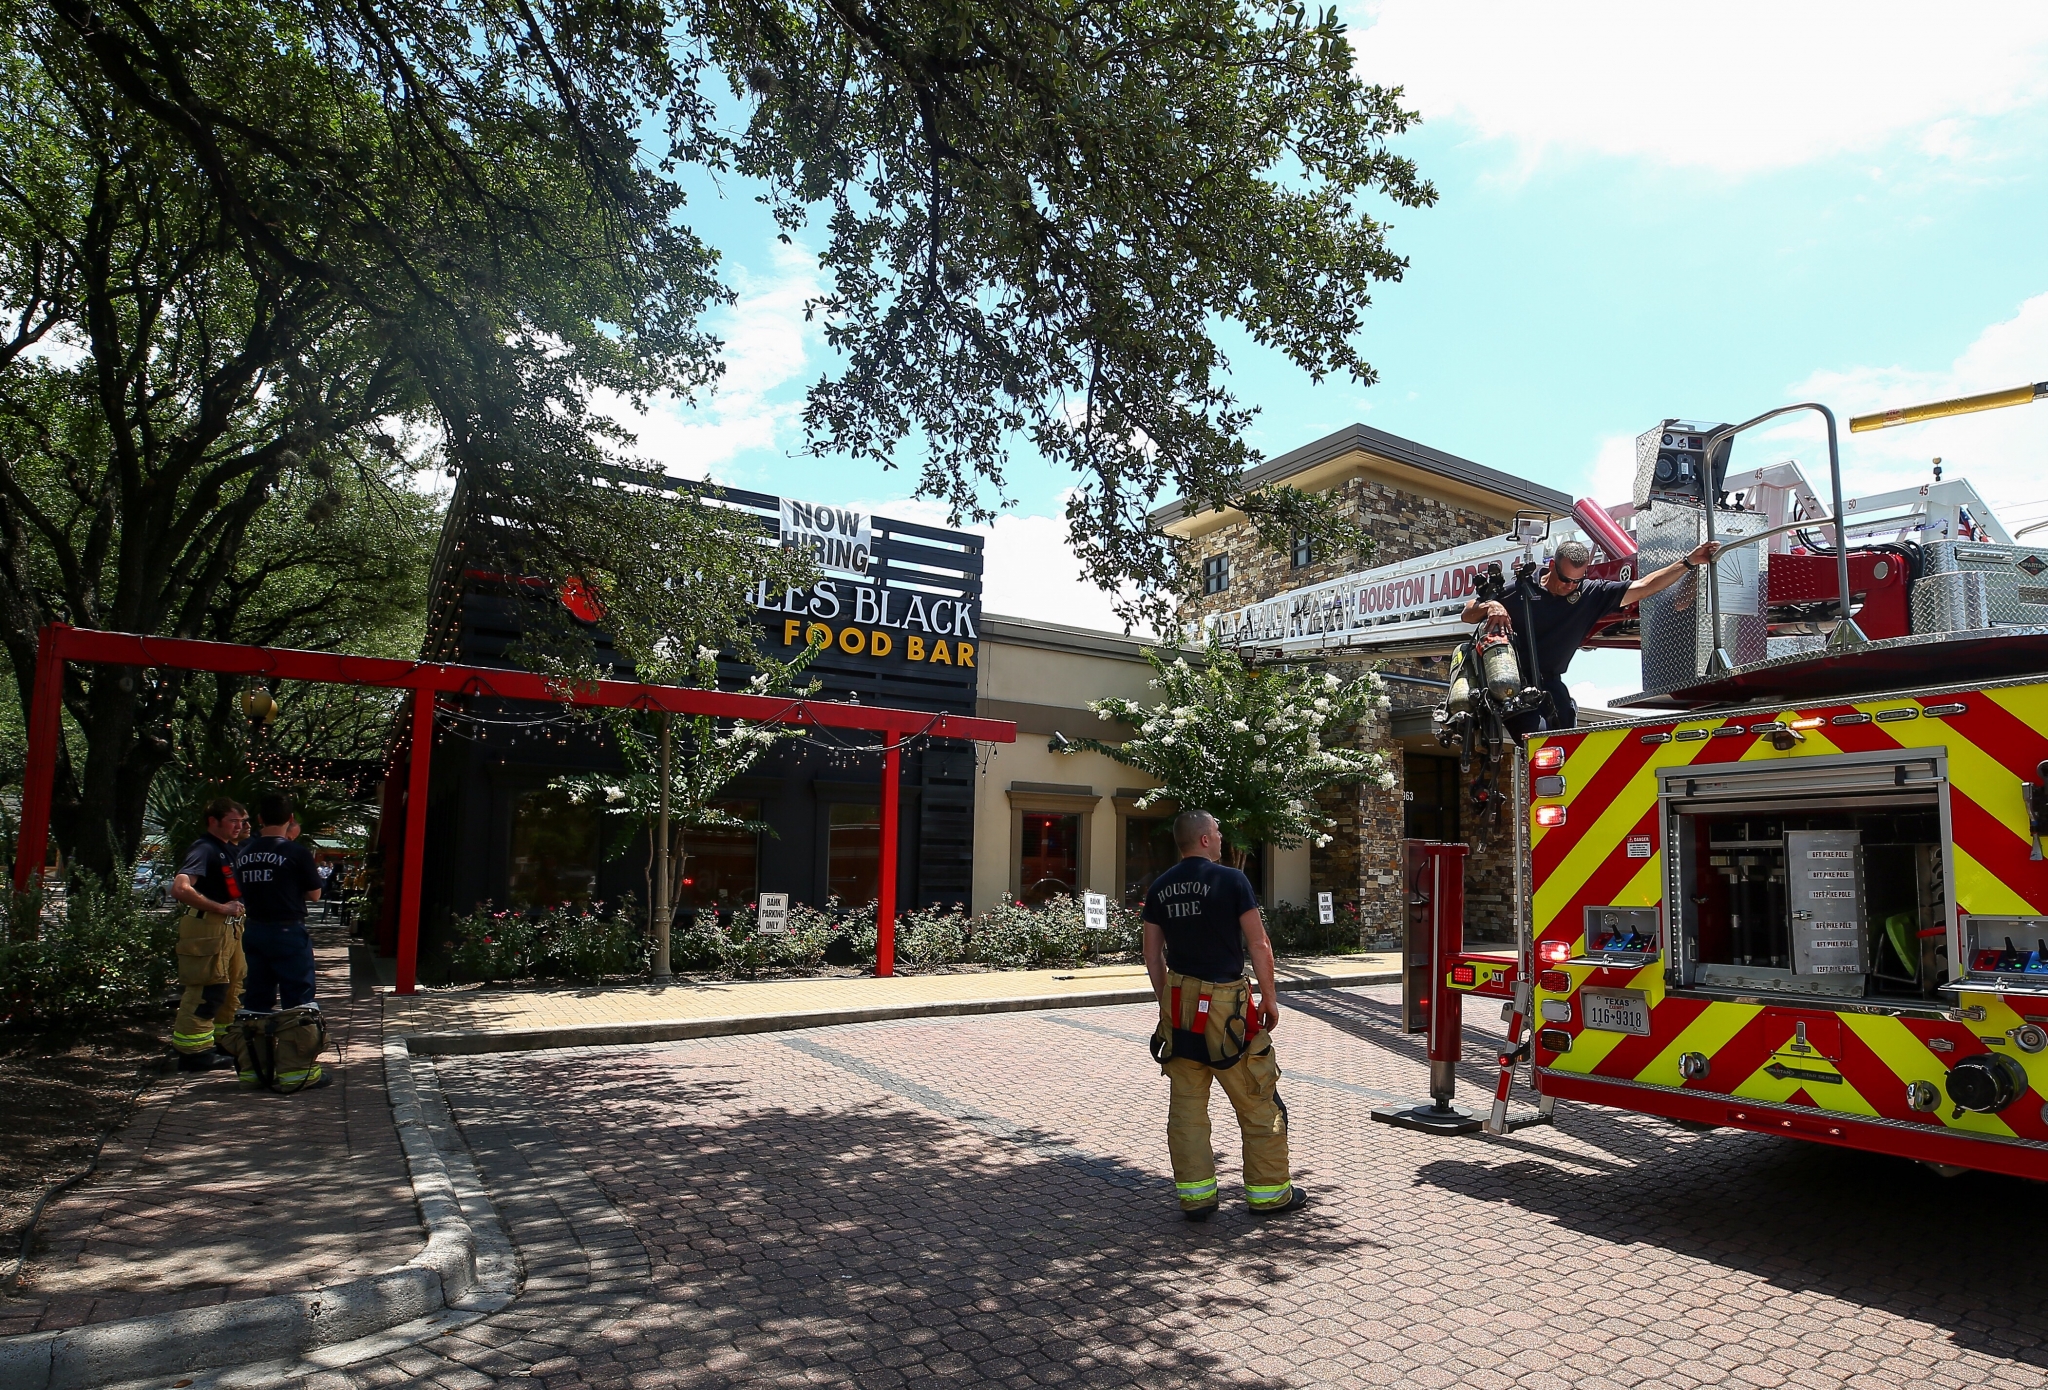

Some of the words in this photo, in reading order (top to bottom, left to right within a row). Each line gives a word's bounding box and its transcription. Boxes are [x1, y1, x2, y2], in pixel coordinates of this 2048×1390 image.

[1754, 467, 1763, 480] 45
[1919, 486, 1929, 496] 45
[1848, 499, 1857, 510] 50
[793, 501, 860, 537] NOW
[1359, 576, 1425, 614] HOUSTON
[854, 586, 978, 639] BLACK
[784, 619, 893, 656] FOOD
[907, 635, 976, 667] BAR
[236, 852, 287, 869] HOUSTON
[242, 869, 273, 883] FIRE
[1157, 881, 1211, 903] HOUSTON
[766, 898, 781, 906] BANK
[762, 909, 784, 918] PARKING
[1165, 901, 1202, 918] FIRE
[766, 921, 780, 929] ONLY
[1605, 998, 1630, 1007] TEXAS
